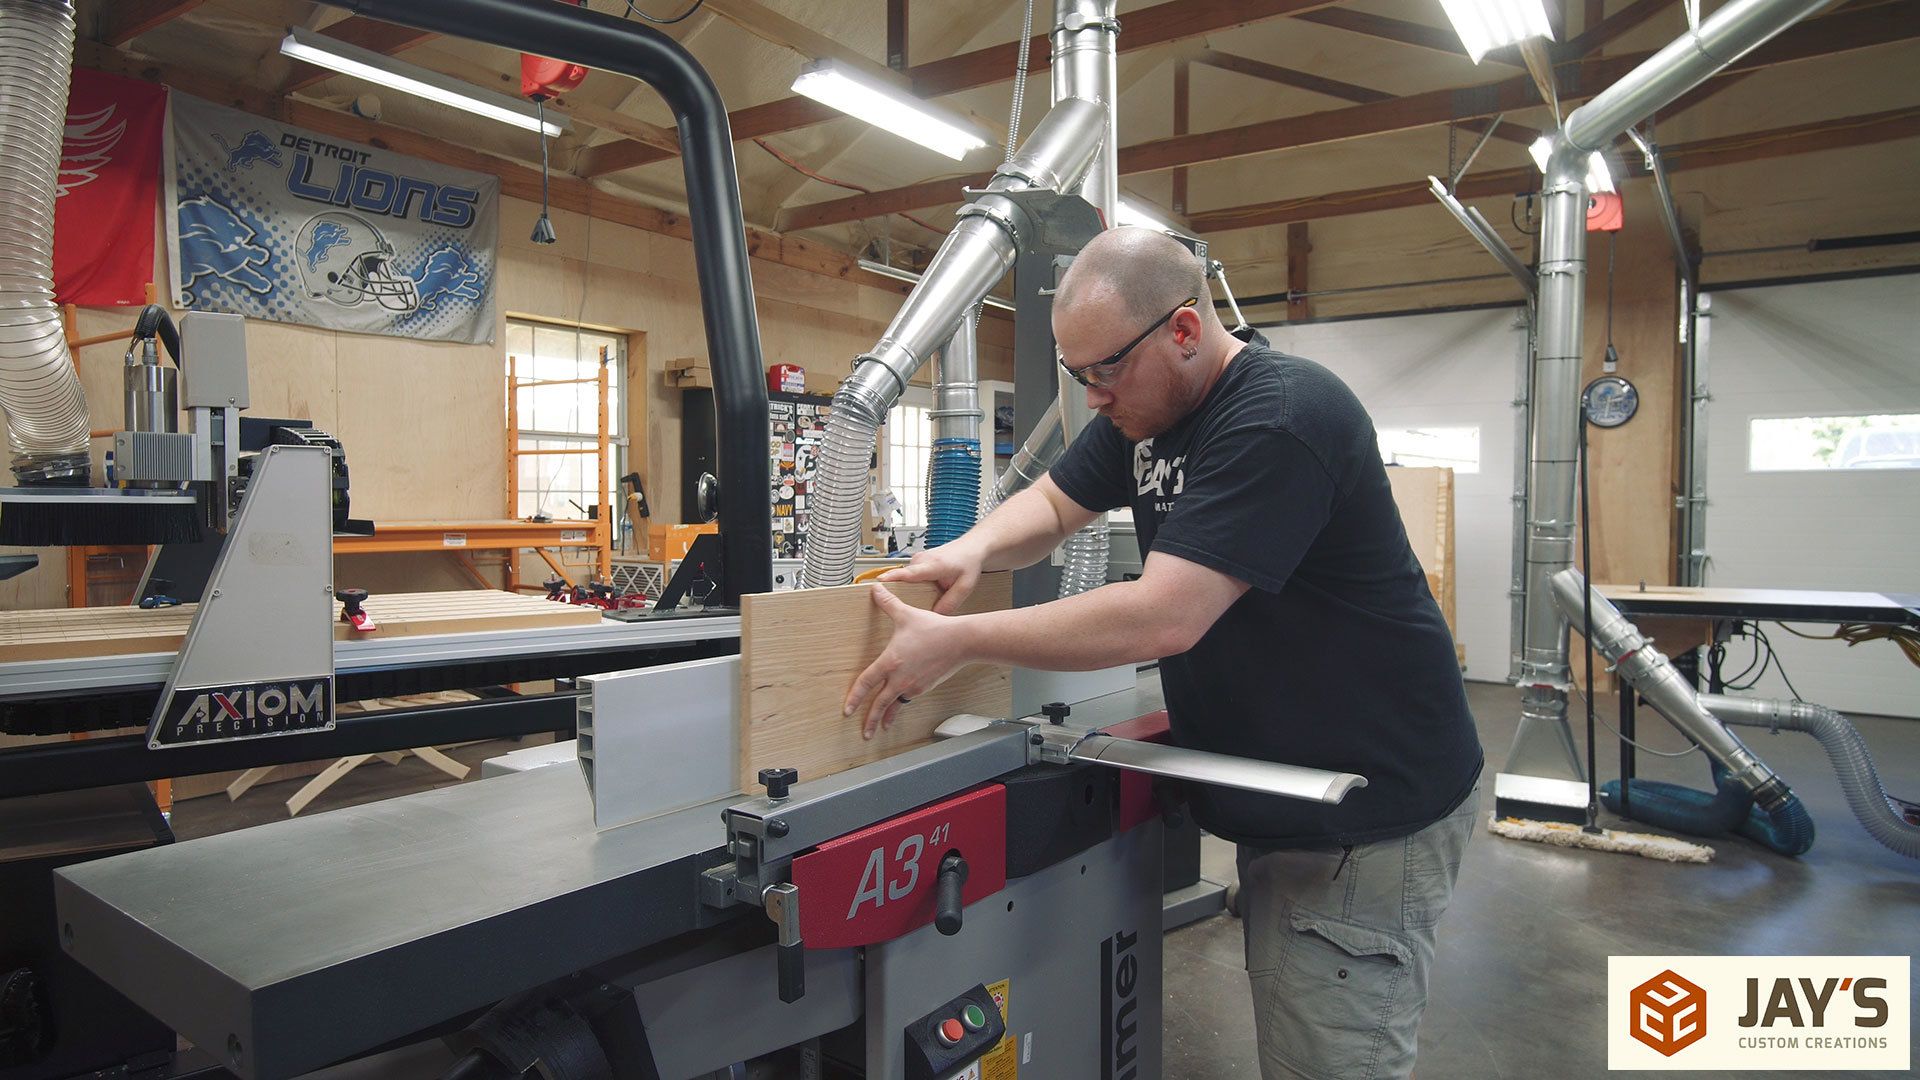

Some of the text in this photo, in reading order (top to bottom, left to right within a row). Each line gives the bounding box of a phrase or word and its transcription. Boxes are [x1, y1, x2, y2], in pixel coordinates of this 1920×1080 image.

[280, 133, 371, 165] DETROIT
[286, 151, 480, 229] LIONS
[776, 504, 793, 517] NAVY
[177, 684, 324, 726] AXIOM
[176, 711, 325, 737] PRECISION
[846, 822, 950, 921] A3 41
